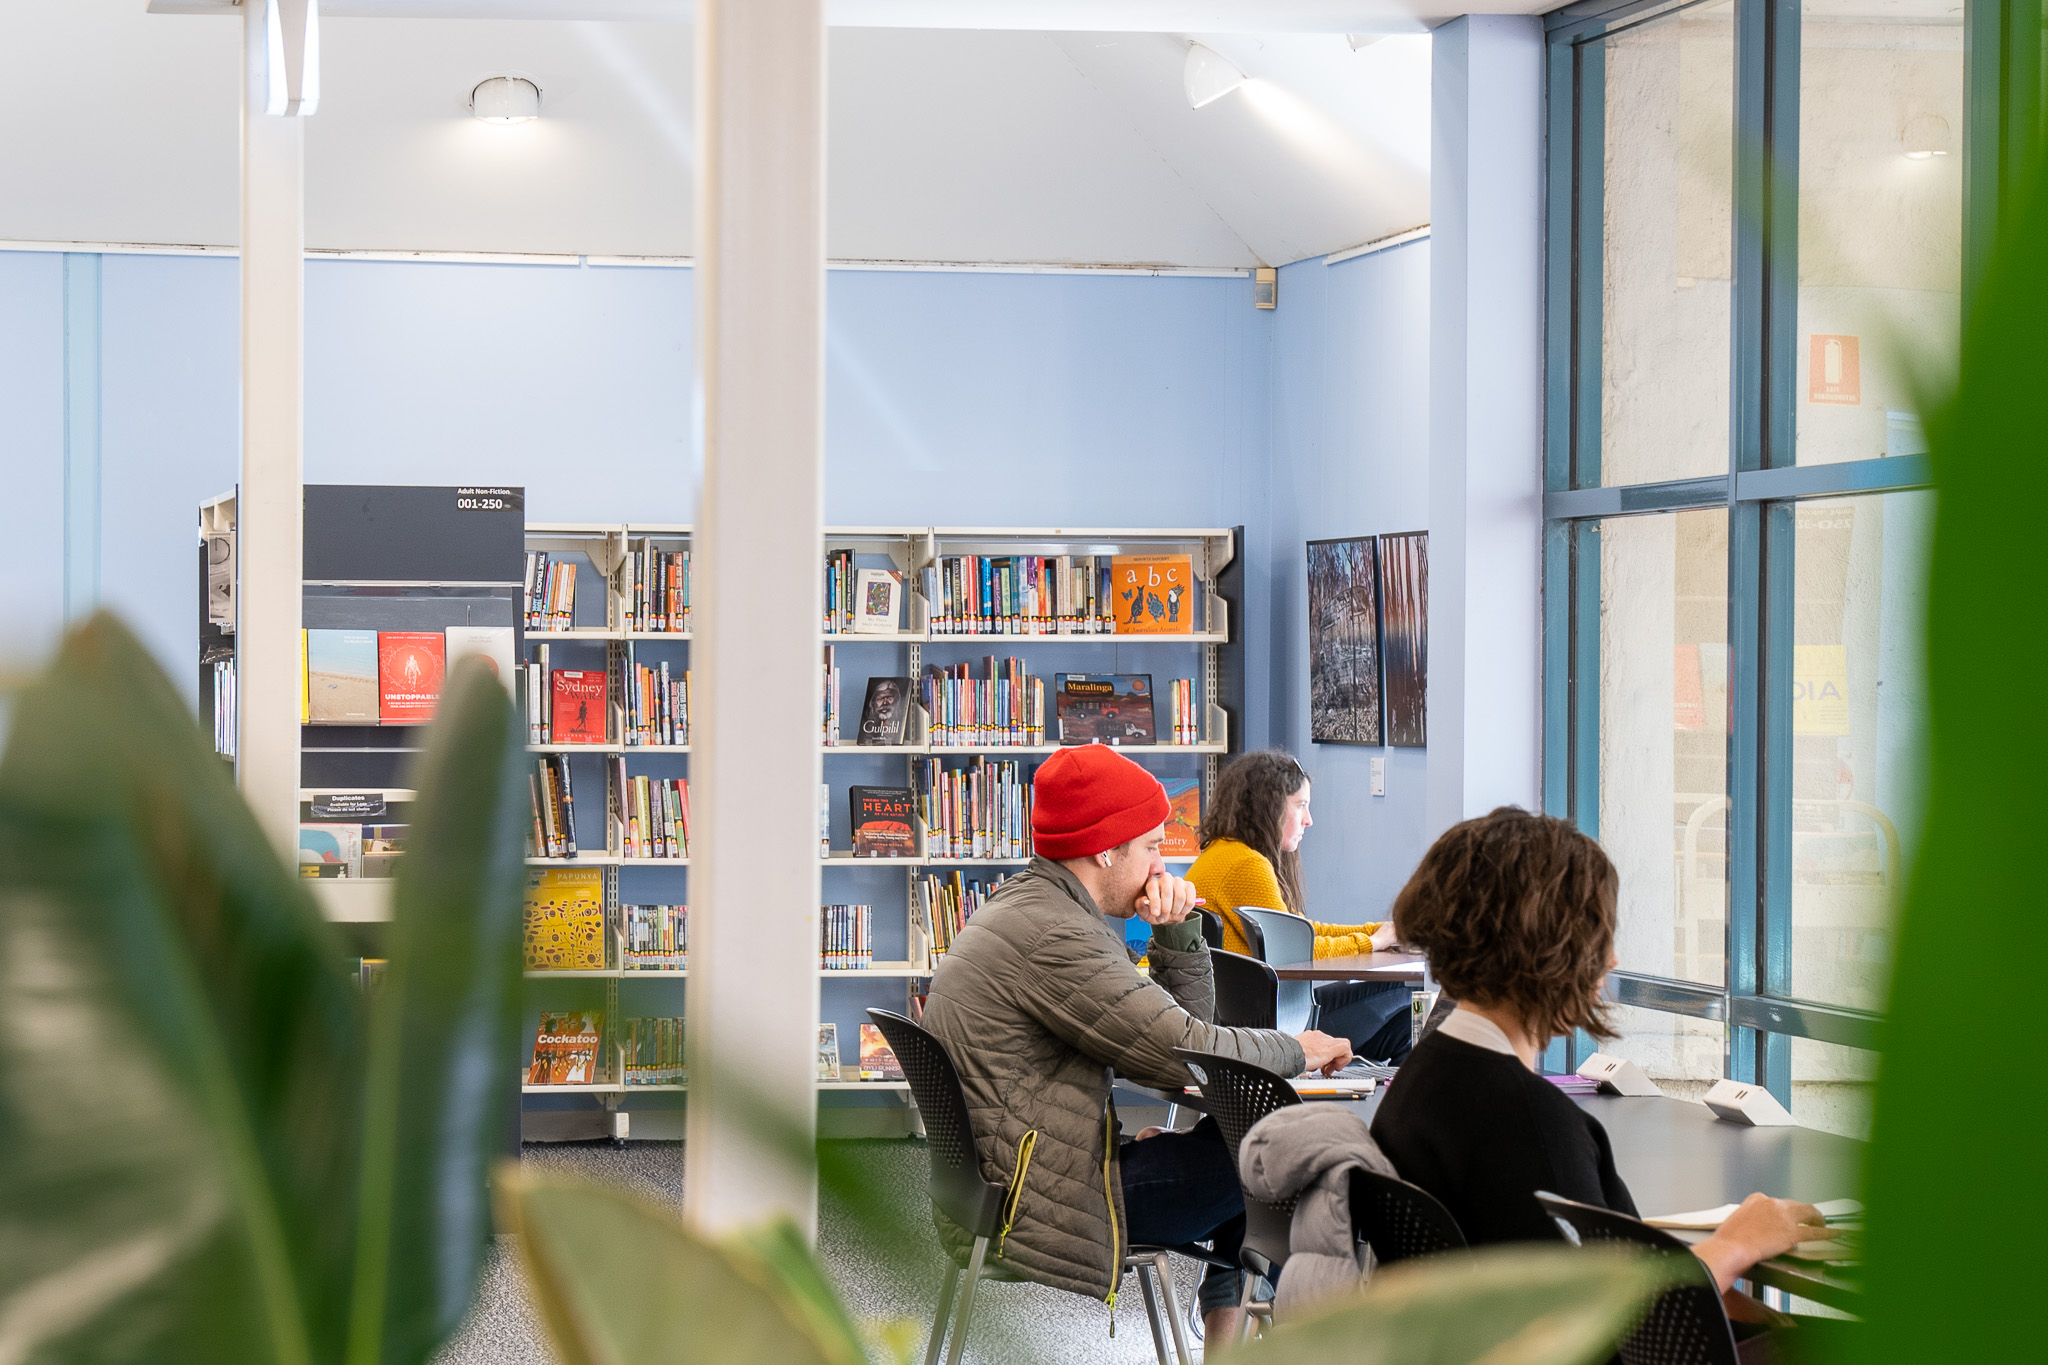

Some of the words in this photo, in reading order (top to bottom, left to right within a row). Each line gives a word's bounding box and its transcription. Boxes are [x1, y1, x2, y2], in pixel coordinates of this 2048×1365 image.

[457, 487, 475, 495] Adult
[457, 498, 503, 510] 001-250
[538, 554, 546, 570] TRUE
[535, 569, 543, 594] TRACKS
[1126, 569, 1138, 583] a
[1148, 566, 1161, 587] b
[1166, 568, 1178, 582] c
[556, 680, 603, 696] Sydney
[1067, 682, 1113, 693] Maralinga
[570, 692, 603, 700] WARS
[863, 720, 900, 736] Gulpilil
[863, 803, 911, 813] HEART
[537, 1034, 598, 1044] Cockatoo
